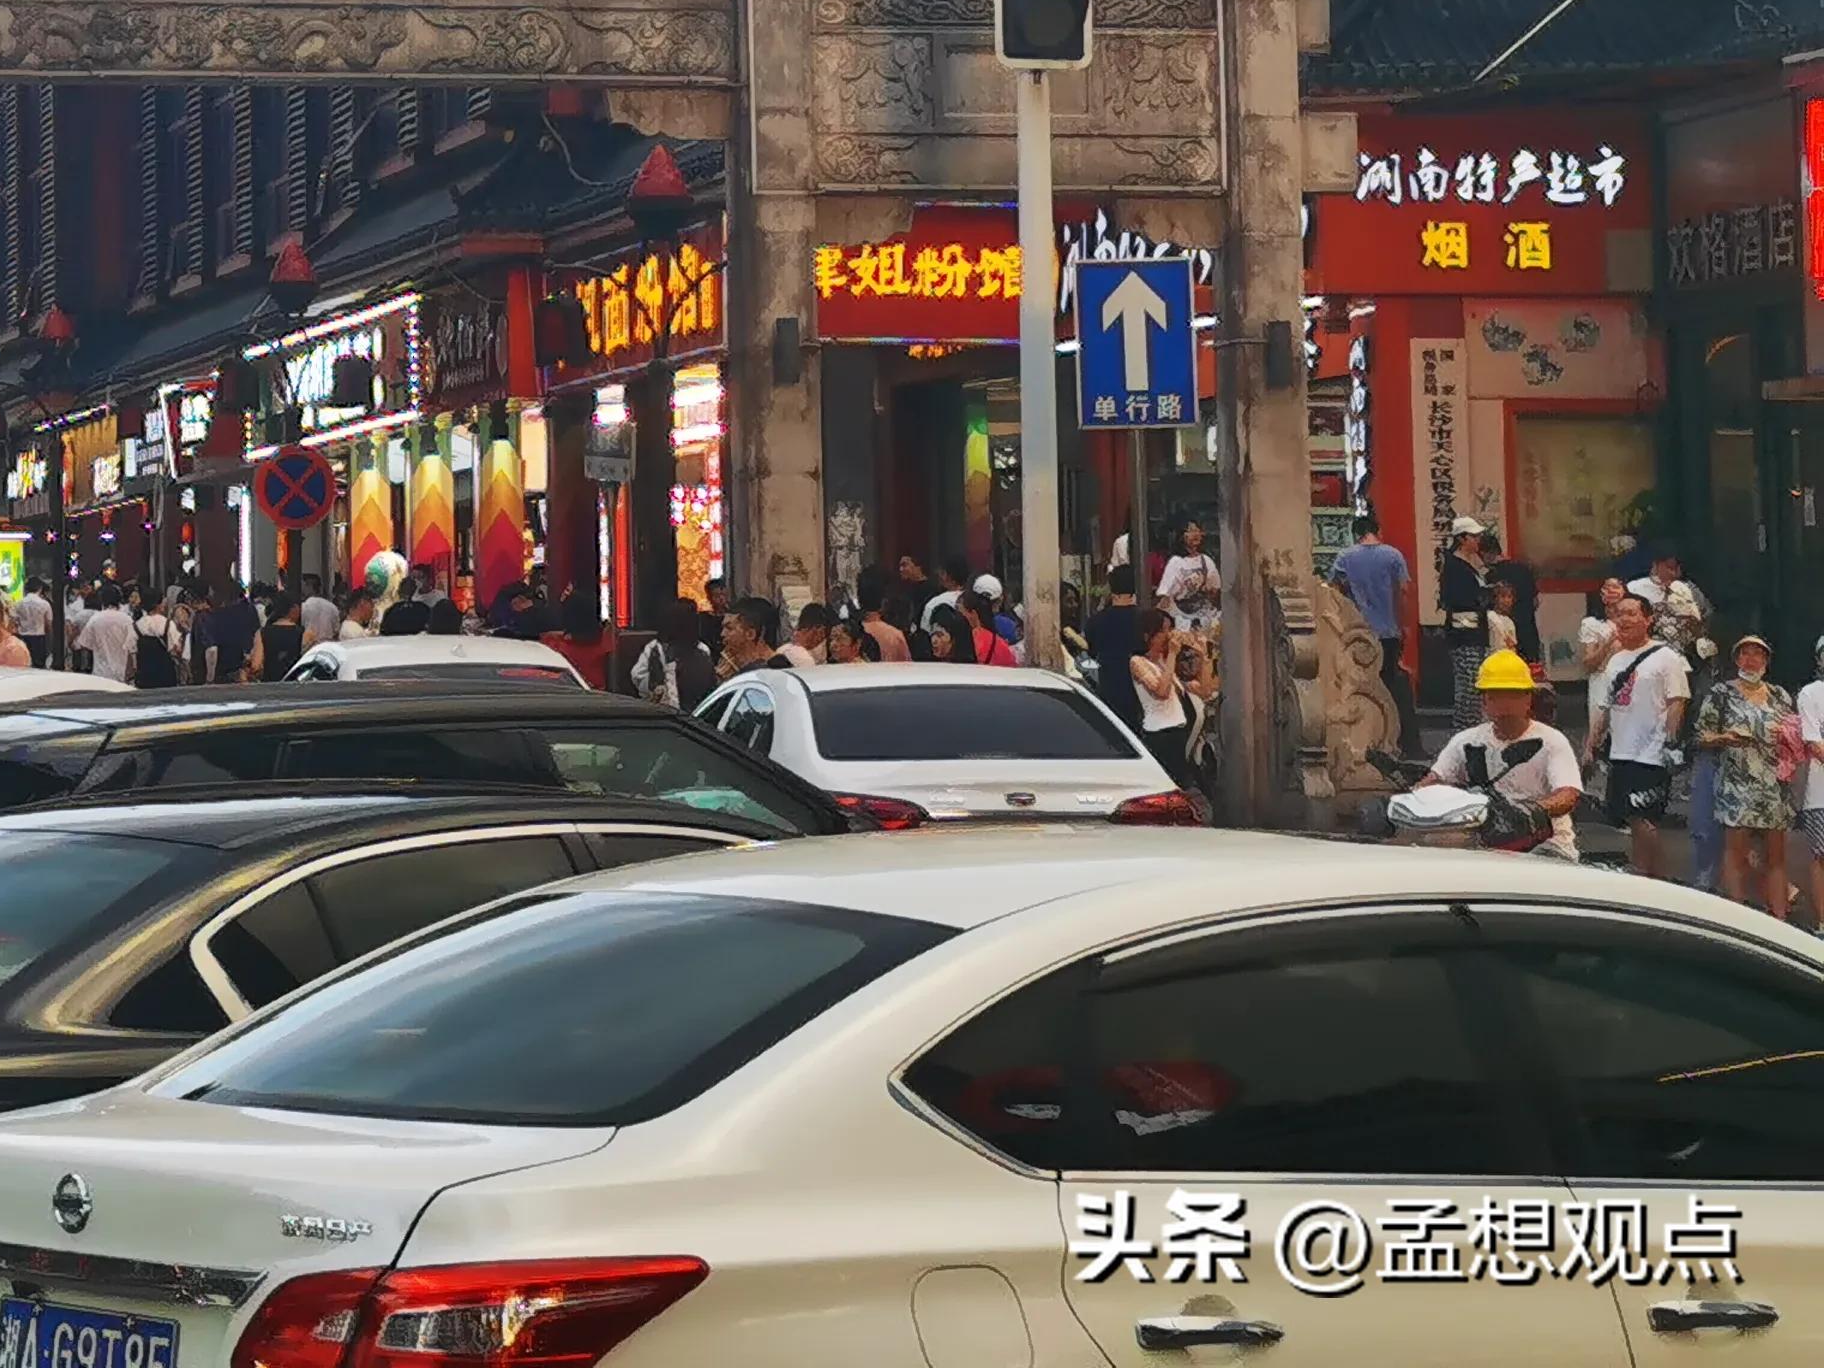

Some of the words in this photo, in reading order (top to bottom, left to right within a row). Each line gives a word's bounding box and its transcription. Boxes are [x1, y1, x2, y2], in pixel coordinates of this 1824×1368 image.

[1355, 144, 1630, 206] 湖南特产超市
[1422, 220, 1552, 270] 烟酒
[1092, 394, 1183, 423] 单行路
